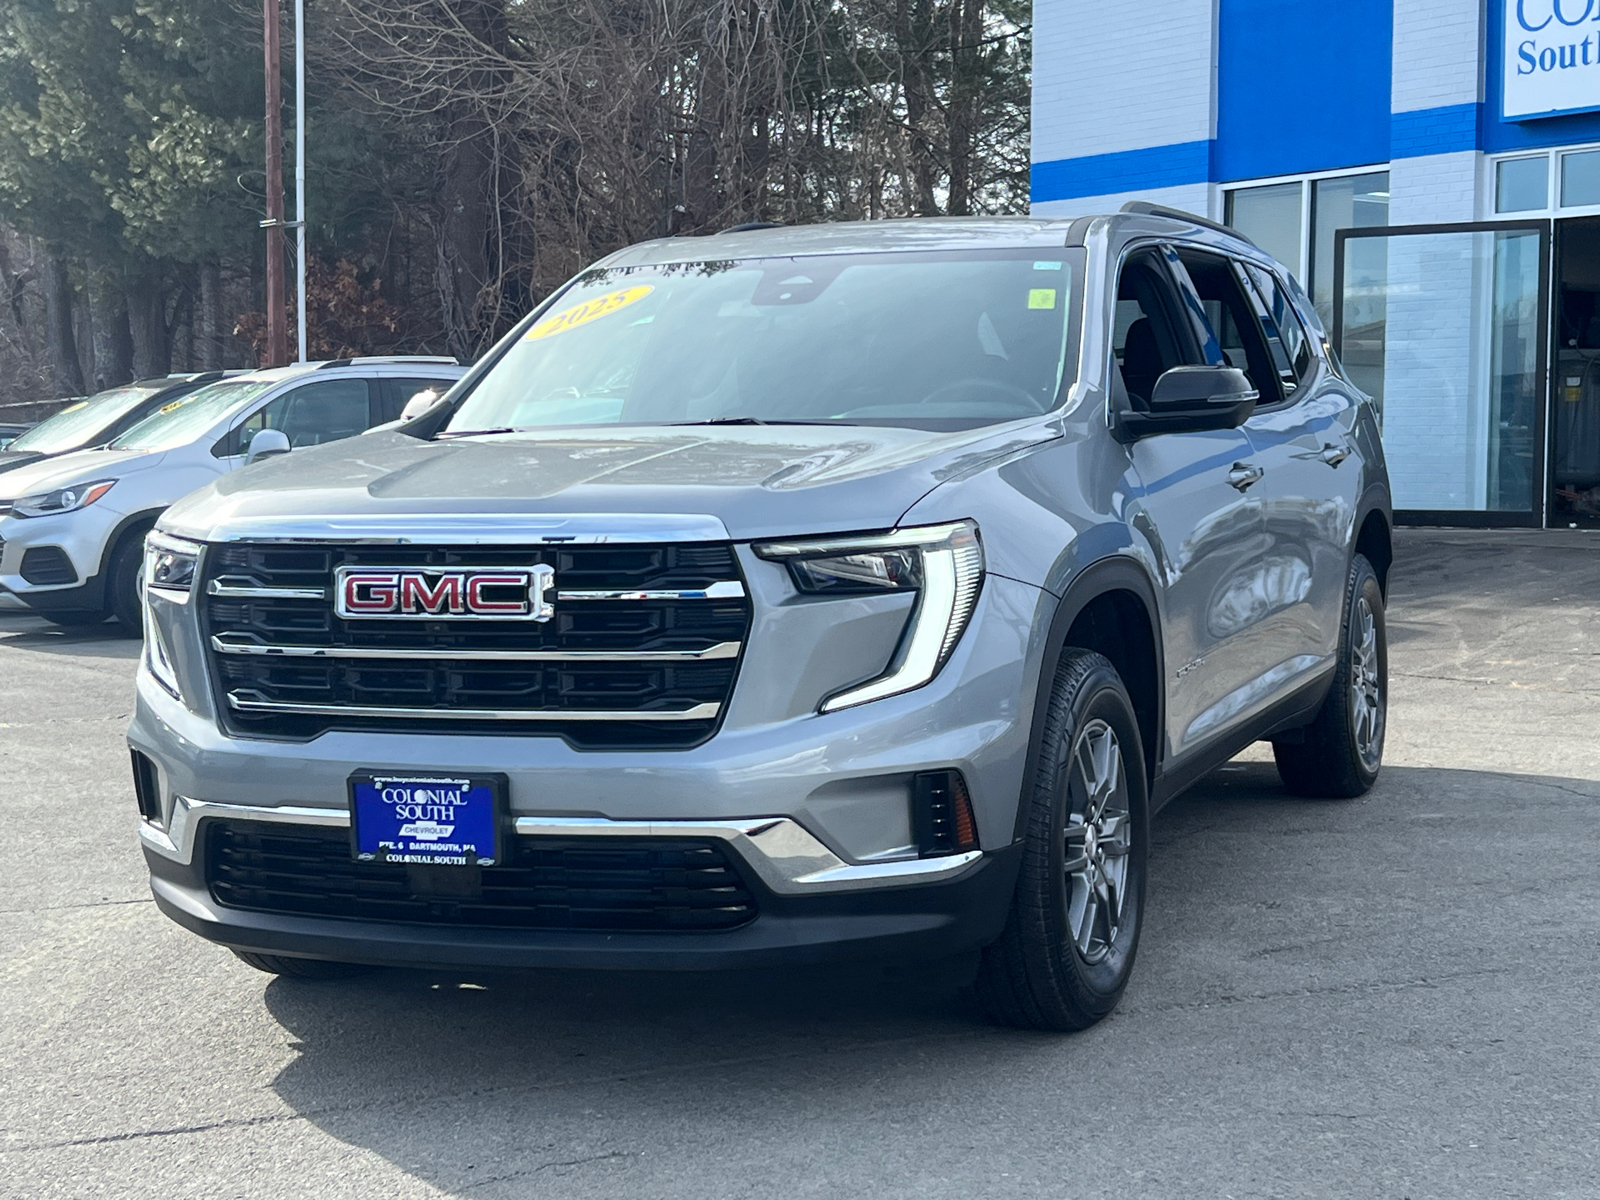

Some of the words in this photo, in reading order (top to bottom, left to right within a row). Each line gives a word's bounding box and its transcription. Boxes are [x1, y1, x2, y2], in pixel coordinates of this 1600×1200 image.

[1517, 0, 1600, 31] CO
[546, 288, 632, 334] 2025
[345, 574, 528, 613] GMC
[381, 788, 467, 806] COLONIAL
[396, 804, 455, 820] SOUTH
[404, 826, 449, 835] CHEVROLET
[409, 842, 462, 853] DARTMOUTH,
[386, 853, 433, 864] COLONIAL
[434, 855, 466, 865] SOUTH
